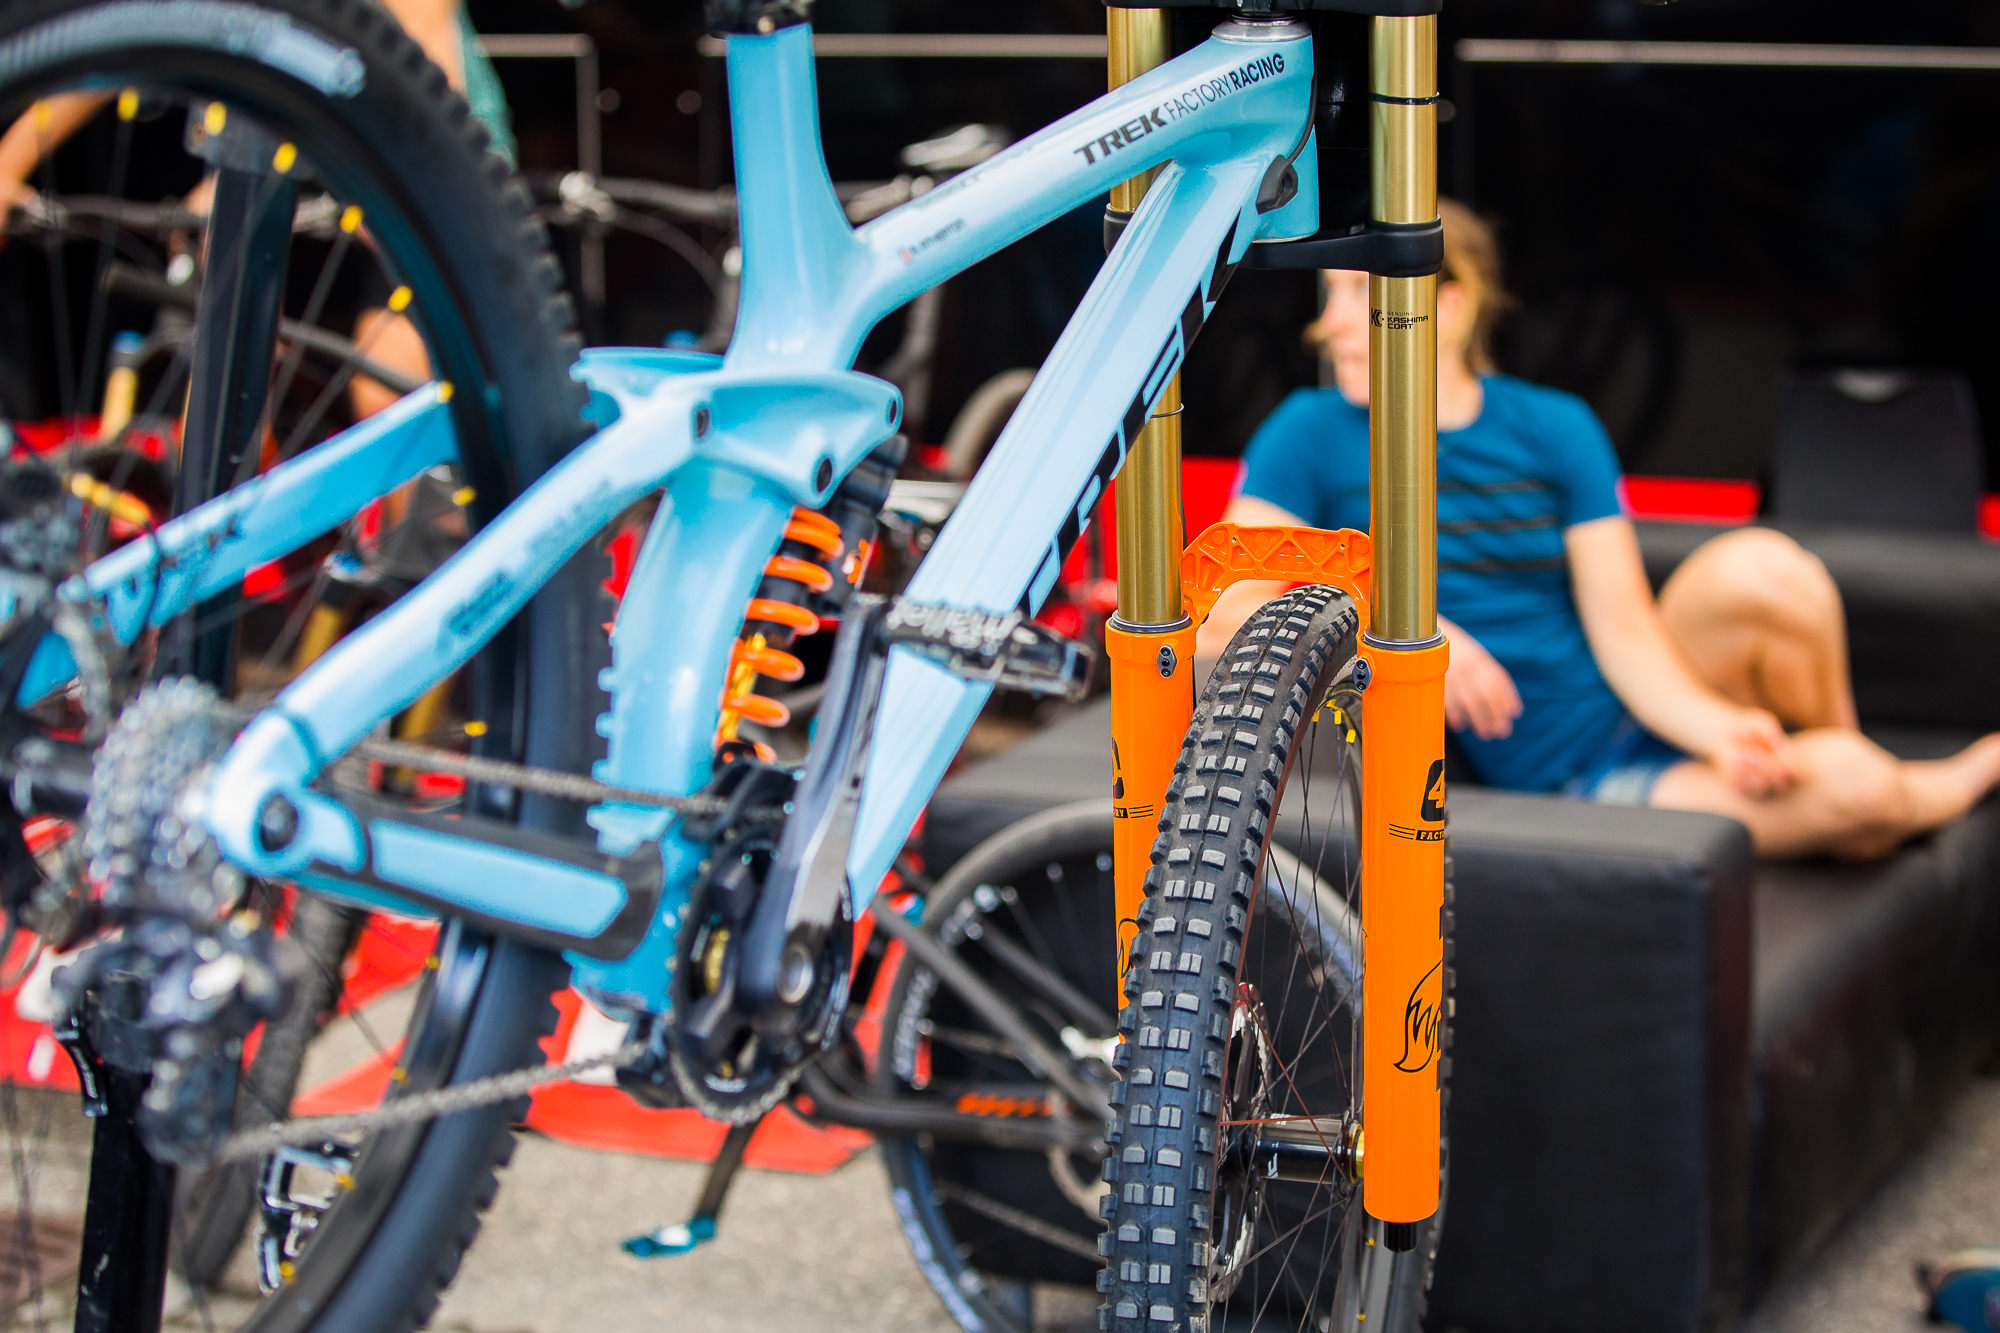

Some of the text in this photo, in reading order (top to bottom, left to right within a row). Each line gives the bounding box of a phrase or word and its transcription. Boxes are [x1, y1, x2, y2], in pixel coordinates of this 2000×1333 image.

[1074, 53, 1285, 165] TREK FACTORY RACING
[1387, 315, 1429, 323] KASHIMA
